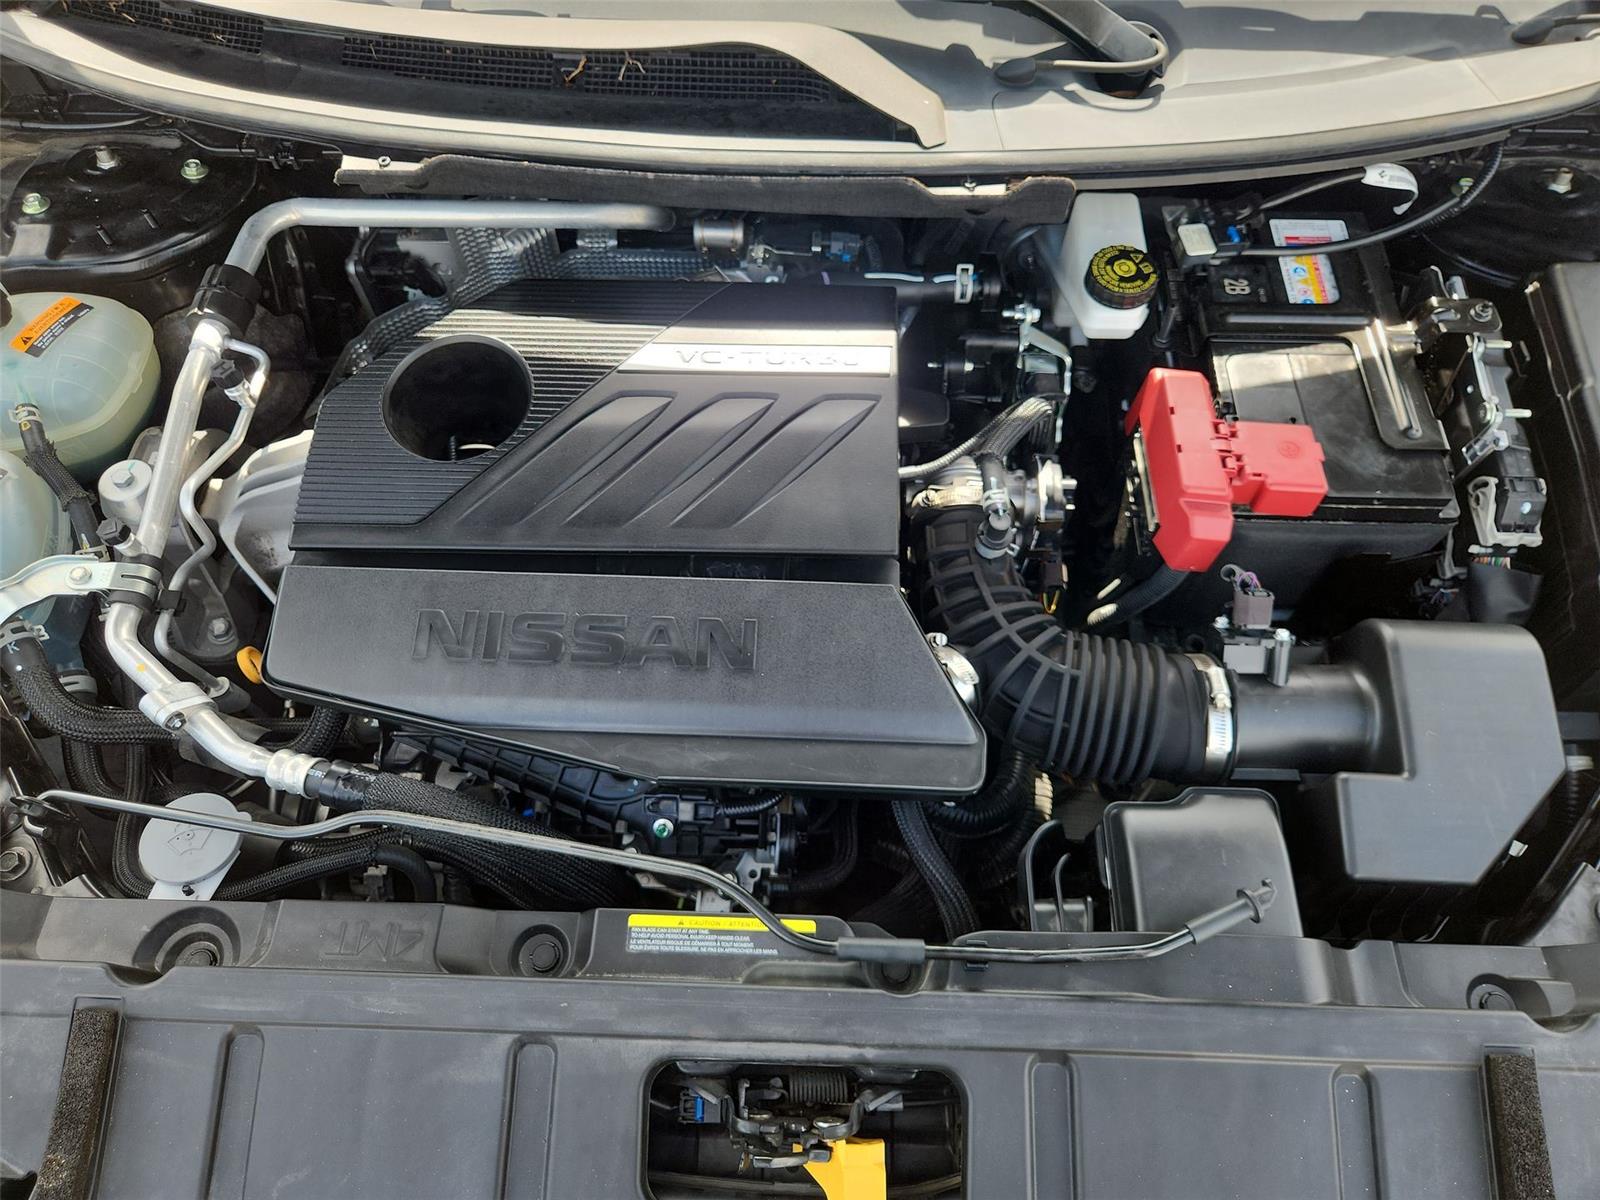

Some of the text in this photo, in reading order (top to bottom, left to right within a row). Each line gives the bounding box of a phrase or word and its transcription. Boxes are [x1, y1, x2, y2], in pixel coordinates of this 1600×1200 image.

[1224, 278, 1251, 295] 2B
[412, 609, 758, 671] NISSAN
[729, 920, 764, 928] ATTENTIO
